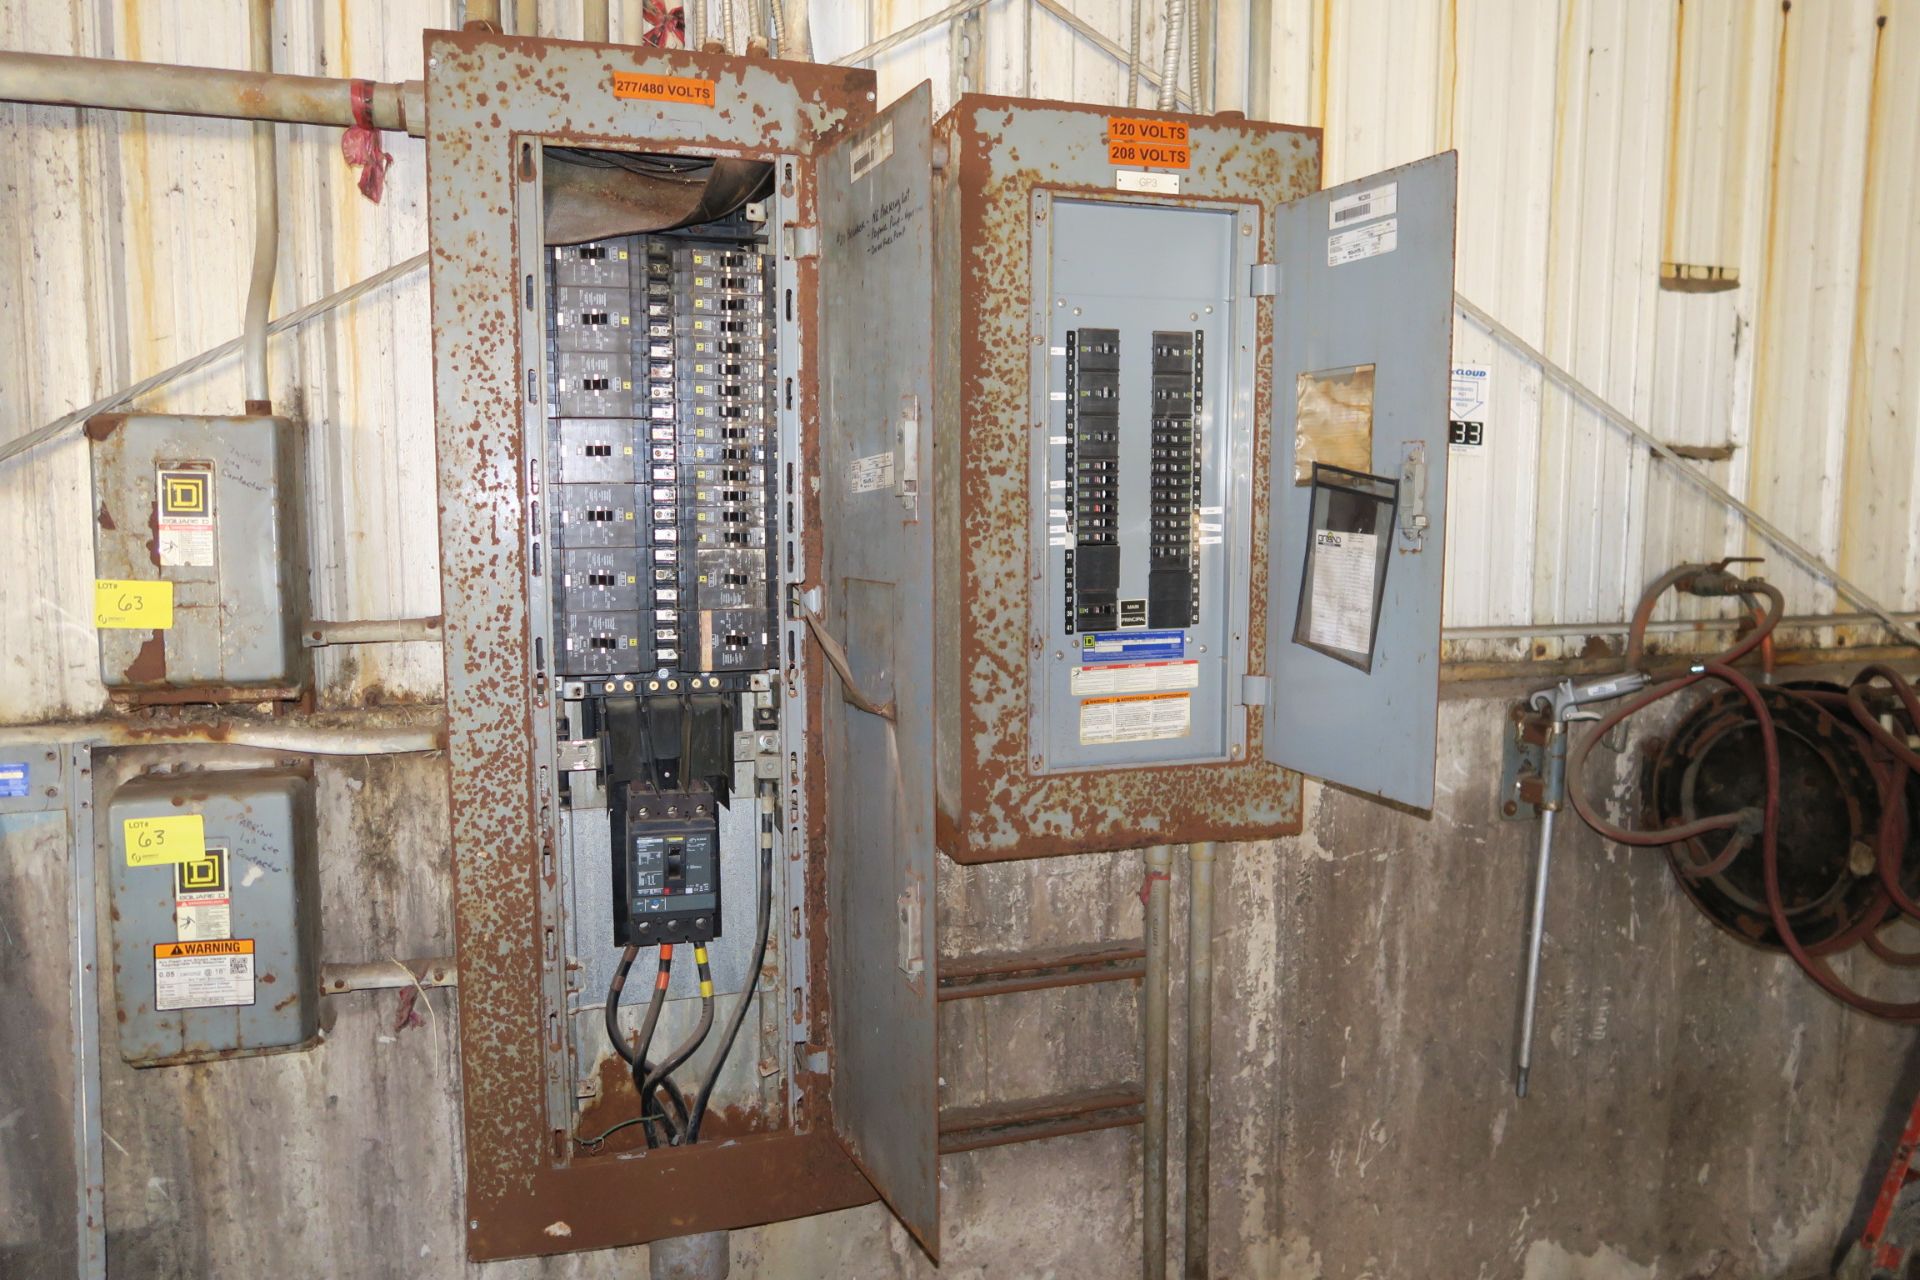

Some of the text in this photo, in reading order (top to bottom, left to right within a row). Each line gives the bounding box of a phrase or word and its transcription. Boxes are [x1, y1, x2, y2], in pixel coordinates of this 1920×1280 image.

[616, 81, 710, 98] 277/480 VOLTS
[1112, 122, 1185, 139] 120 VOLTS
[1112, 146, 1186, 162] 208 VOLTS
[118, 594, 143, 611] 63
[138, 830, 165, 847] 63
[185, 942, 240, 954] WARNING
